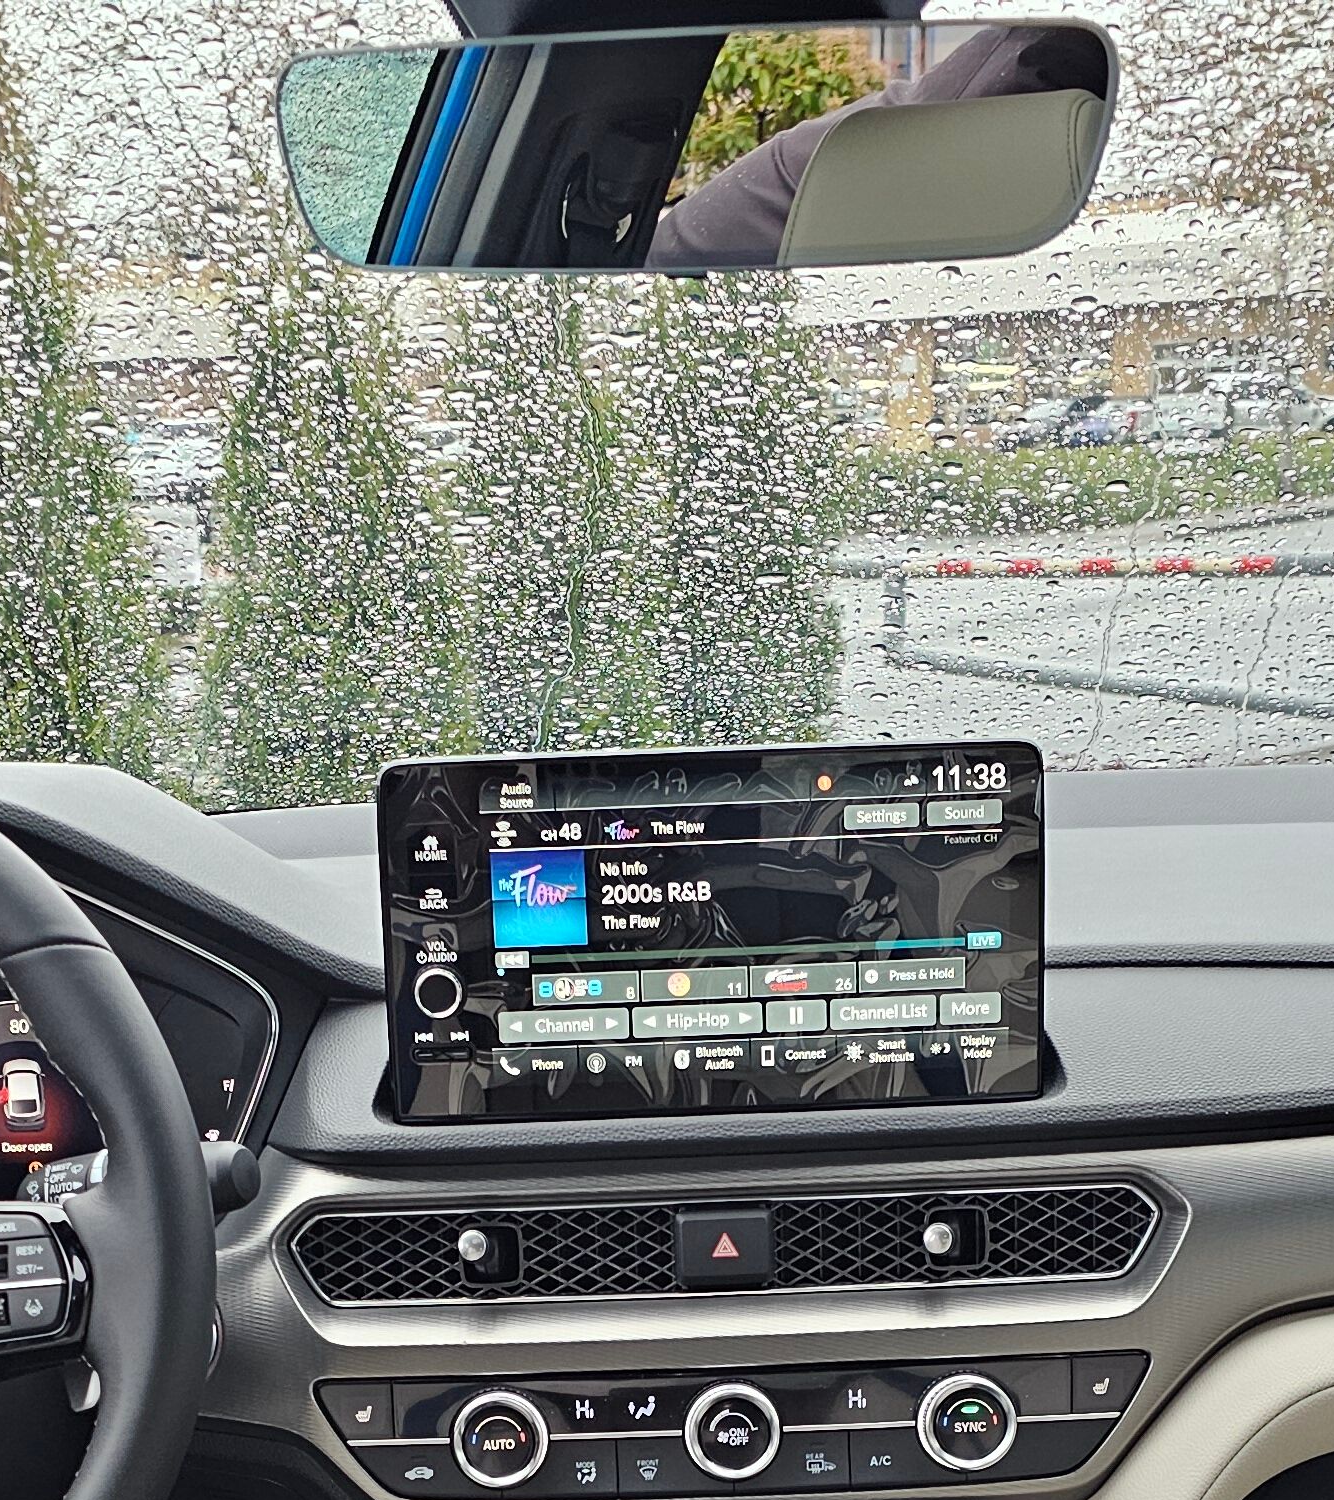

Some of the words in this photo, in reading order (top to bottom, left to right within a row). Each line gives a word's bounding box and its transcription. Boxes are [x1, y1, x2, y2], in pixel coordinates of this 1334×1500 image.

[932, 762, 1008, 792] 11:38
[500, 782, 532, 795] Audio
[499, 797, 534, 809] Source
[856, 809, 908, 825] Settings
[944, 804, 985, 820] Sound
[540, 829, 558, 841] CH
[559, 822, 582, 840] 48
[650, 821, 673, 836] The
[675, 820, 705, 835] Flow
[943, 834, 982, 845] Featured
[983, 833, 998, 843] CH
[414, 849, 448, 862] HOME
[600, 861, 619, 877] No
[622, 861, 648, 876] Info
[510, 864, 576, 908] Flow
[601, 884, 663, 905] 2000s
[667, 881, 712, 903] R&B
[419, 898, 449, 910] BACK
[602, 915, 627, 930] The
[629, 914, 661, 929] Flow
[426, 941, 447, 952] VOL
[971, 935, 996, 947] LIVE
[428, 952, 458, 963] AUDIO
[888, 969, 916, 982] Press
[918, 969, 928, 980] &
[929, 968, 955, 980] Hold
[727, 982, 742, 996] 11
[835, 978, 853, 991] 26
[626, 986, 635, 1000] 8
[839, 1005, 899, 1021] Channel
[901, 1003, 928, 1019] List
[951, 1001, 990, 1017] More
[9, 1019, 29, 1034] 80
[534, 1017, 594, 1034] Channel
[666, 1010, 730, 1031] Hip-Hop
[877, 1038, 906, 1050] Smart
[960, 1035, 996, 1048] Display
[695, 1045, 744, 1059] Bluetooth
[784, 1049, 826, 1061] Connect
[869, 1051, 915, 1064] Shortcuts
[963, 1047, 992, 1060] Mode
[532, 1059, 564, 1071] Phone
[625, 1056, 642, 1067] FM
[705, 1058, 735, 1071] Audio
[1, 1142, 27, 1153] Door
[49, 1181, 73, 1194] AUTO
[729, 1427, 749, 1438] ON/
[954, 1421, 987, 1433] SYNC
[482, 1437, 515, 1451] AUTO
[729, 1435, 749, 1446] OFF
[575, 1460, 596, 1469] MODE
[636, 1458, 659, 1467] FRONT
[870, 1454, 892, 1467] A/C
